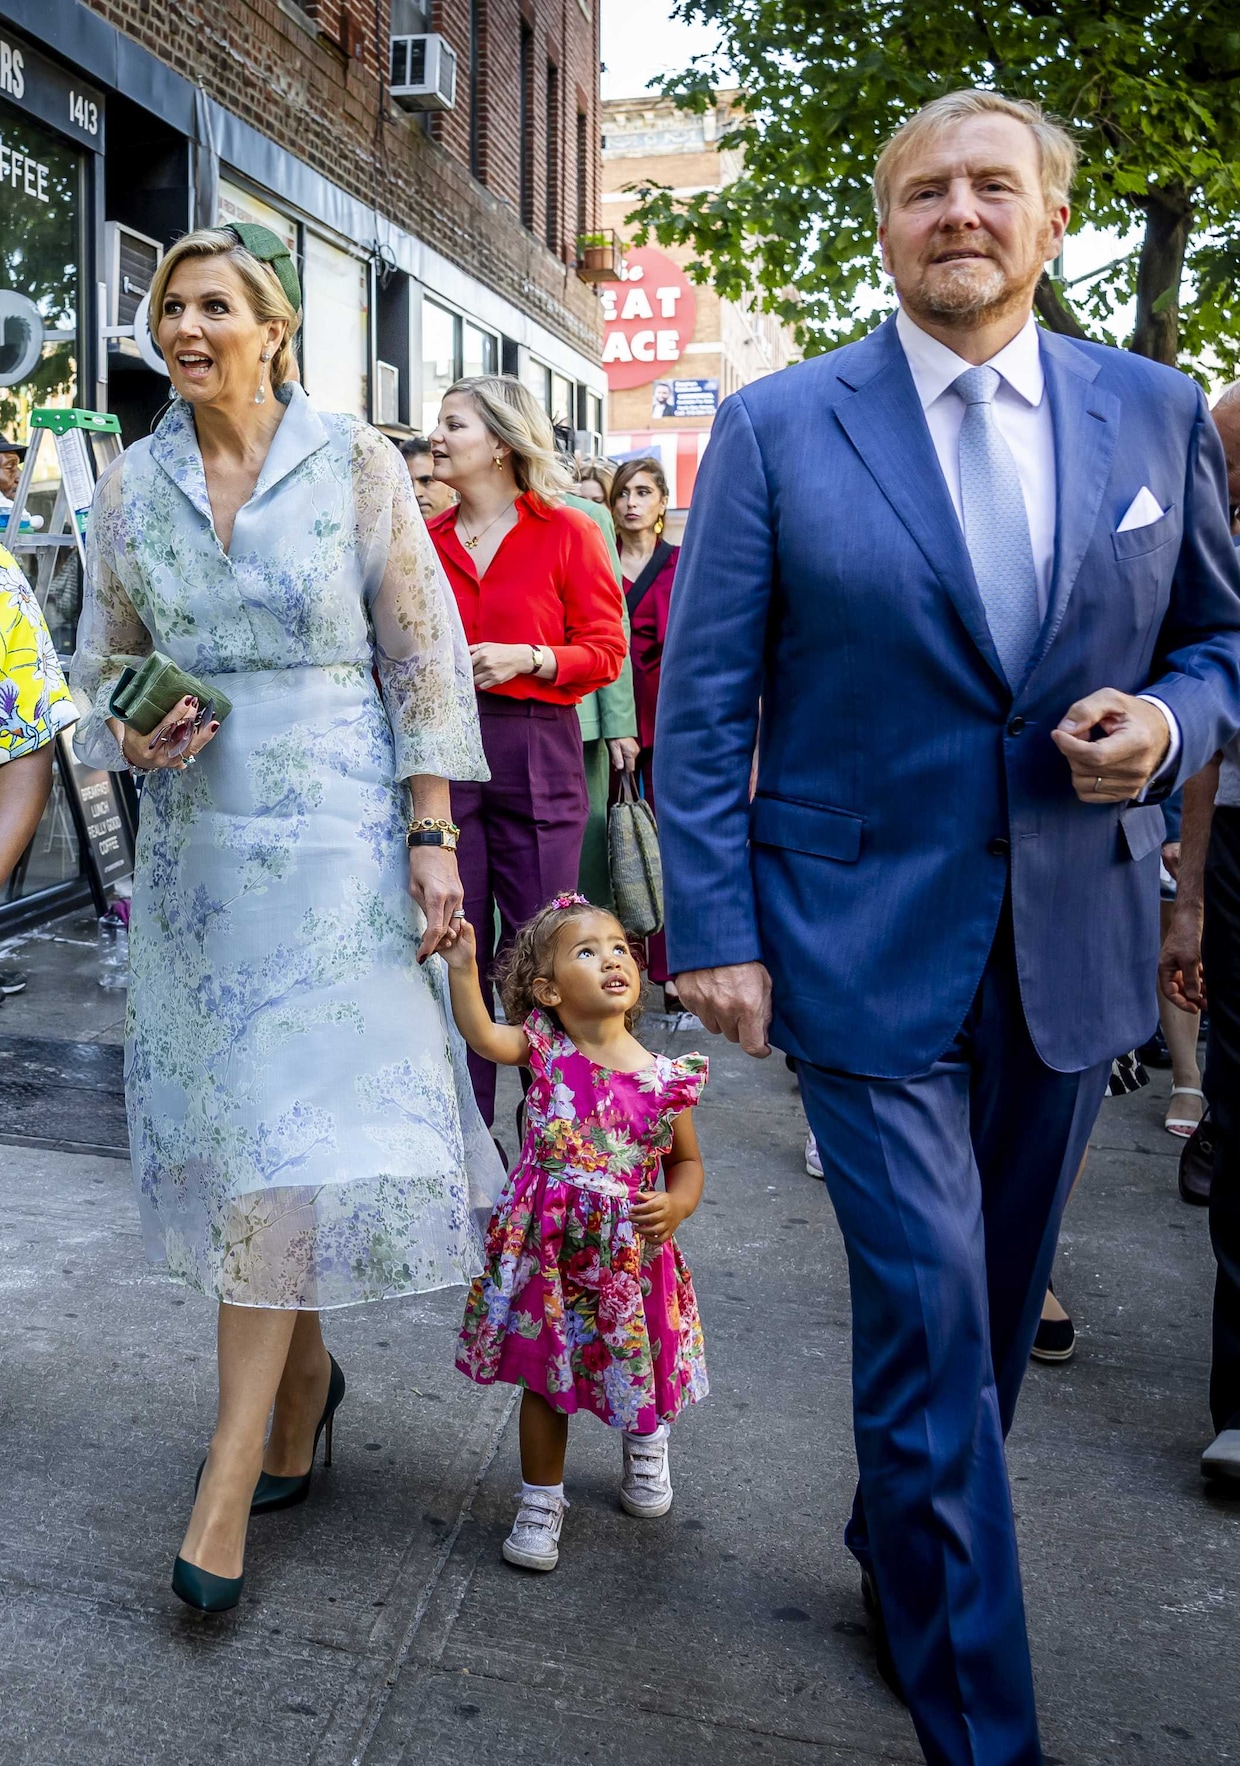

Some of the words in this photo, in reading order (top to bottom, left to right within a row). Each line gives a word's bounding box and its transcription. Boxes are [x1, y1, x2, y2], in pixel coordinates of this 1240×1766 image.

[69, 90, 98, 136] 1413
[601, 286, 681, 321] EAT
[601, 329, 680, 363] ACE
[80, 781, 110, 802] BREAKFAST
[90, 801, 109, 818] LUNCH
[87, 821, 107, 839] REALLY
[106, 815, 122, 833] GOOD
[98, 835, 120, 856] COFFEE
